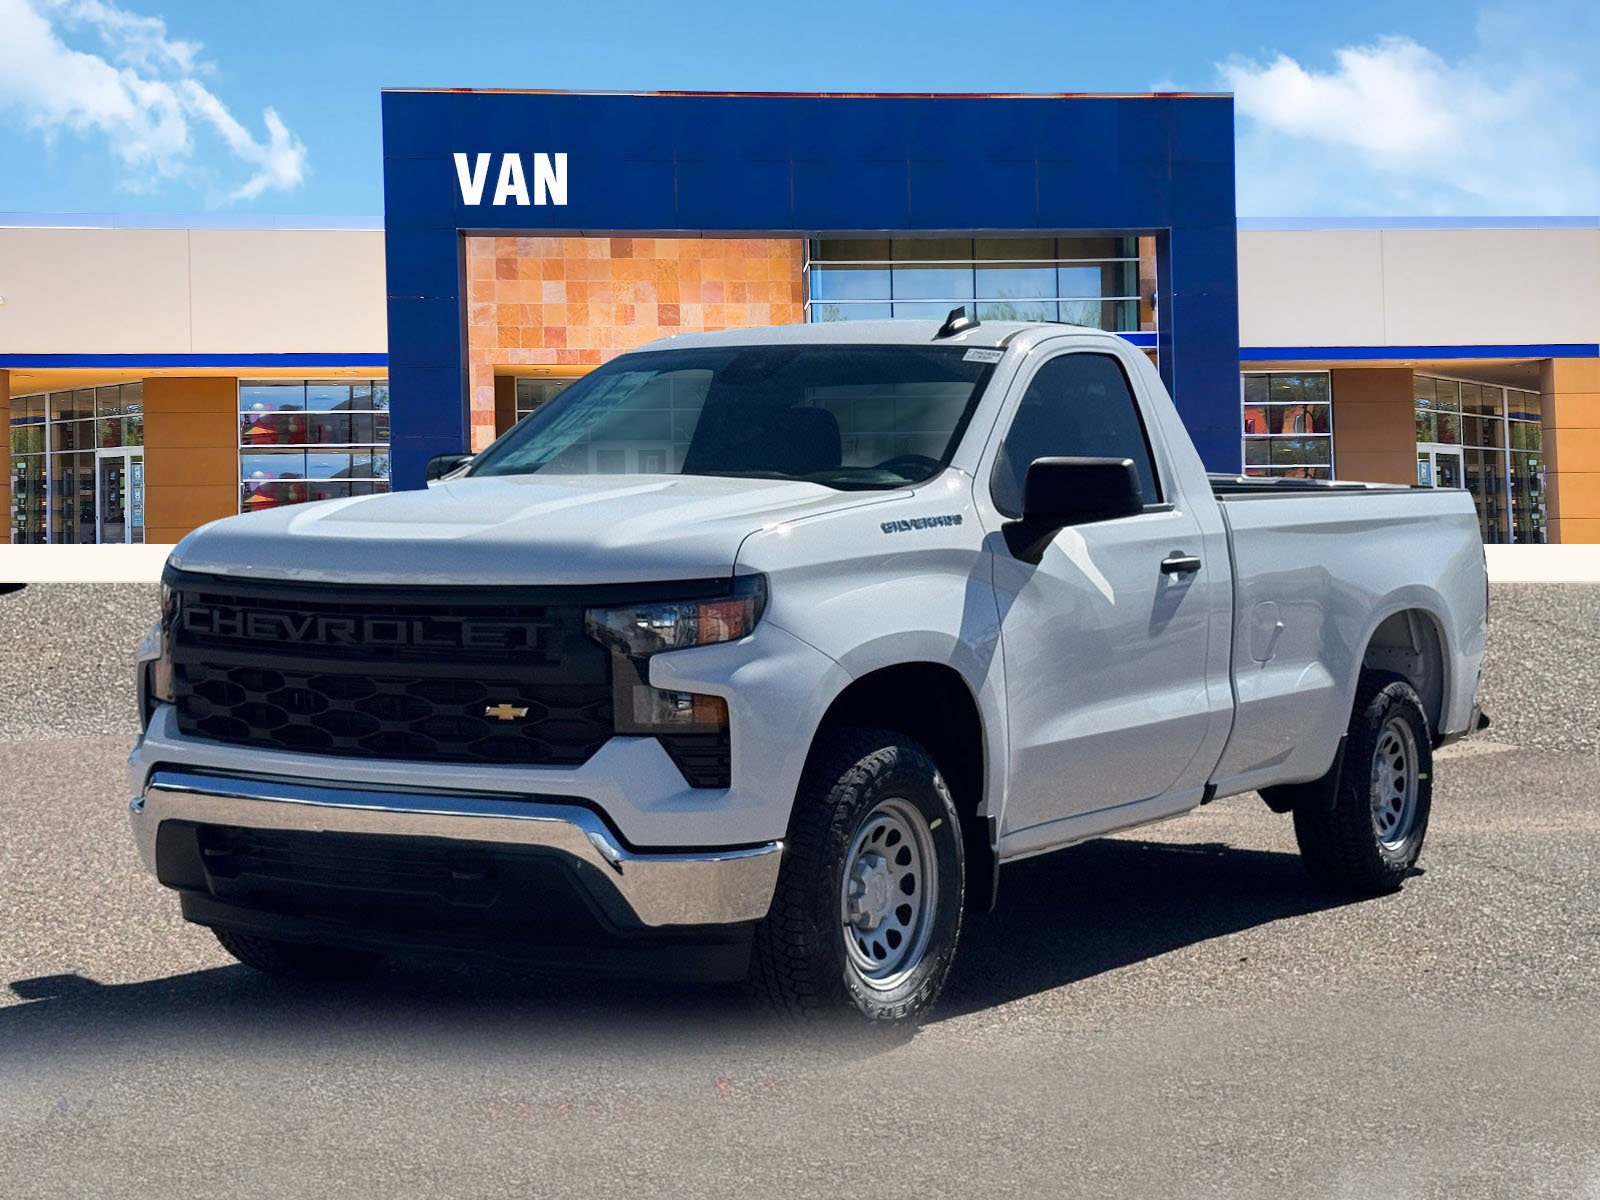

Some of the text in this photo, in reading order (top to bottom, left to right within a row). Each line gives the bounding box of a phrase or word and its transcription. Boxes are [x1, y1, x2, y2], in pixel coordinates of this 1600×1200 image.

[453, 153, 568, 206] VAN
[881, 514, 963, 534] SILVERADO
[183, 607, 550, 650] CHEVROLET
